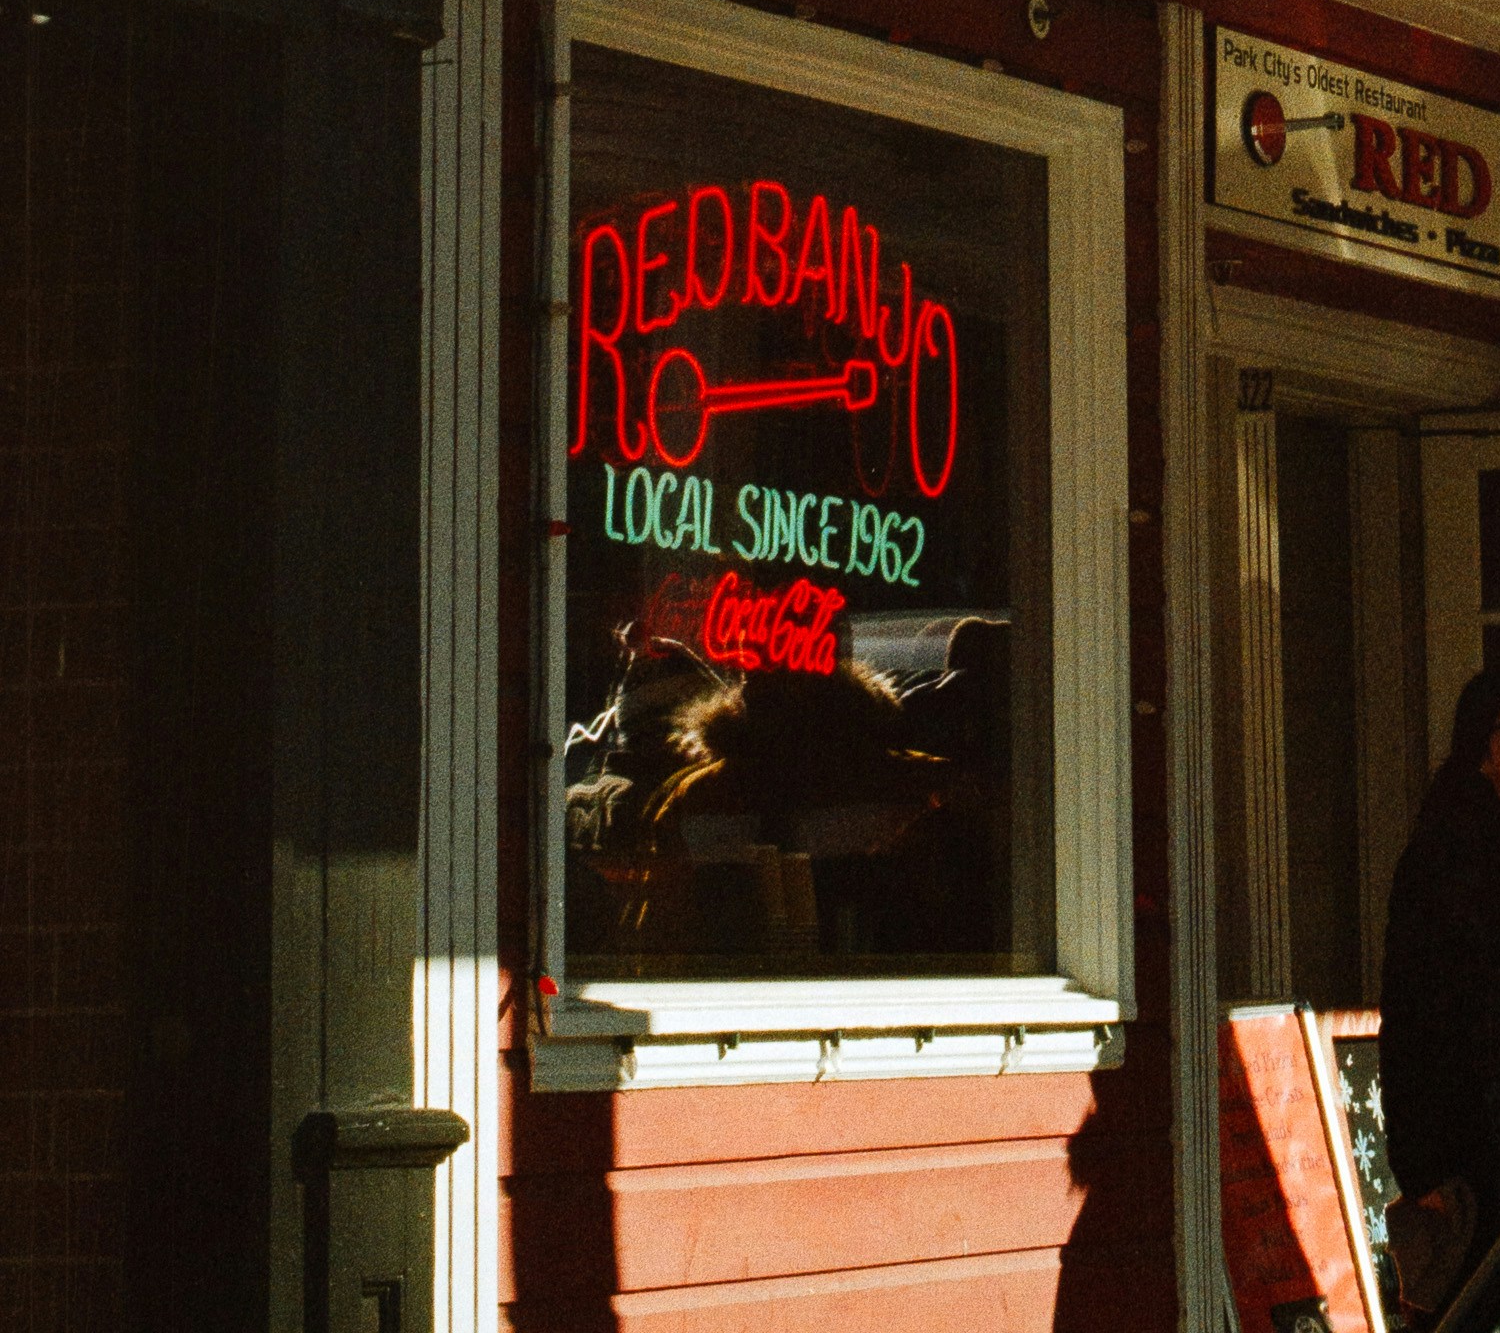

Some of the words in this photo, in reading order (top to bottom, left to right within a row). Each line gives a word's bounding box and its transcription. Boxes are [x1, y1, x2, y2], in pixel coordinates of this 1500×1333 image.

[1223, 38, 1258, 72] Park
[1263, 51, 1302, 87] City's
[1307, 64, 1350, 99] Oldest
[1355, 79, 1427, 121] Restaurant
[1349, 113, 1492, 220] RED
[1291, 188, 1419, 244] Sandwiches
[1446, 228, 1500, 266] Pizza
[569, 186, 734, 461] RED
[741, 180, 959, 499] BANJO
[604, 463, 722, 555] LOCAL
[732, 483, 844, 571] SINCE
[844, 500, 926, 588] 1962
